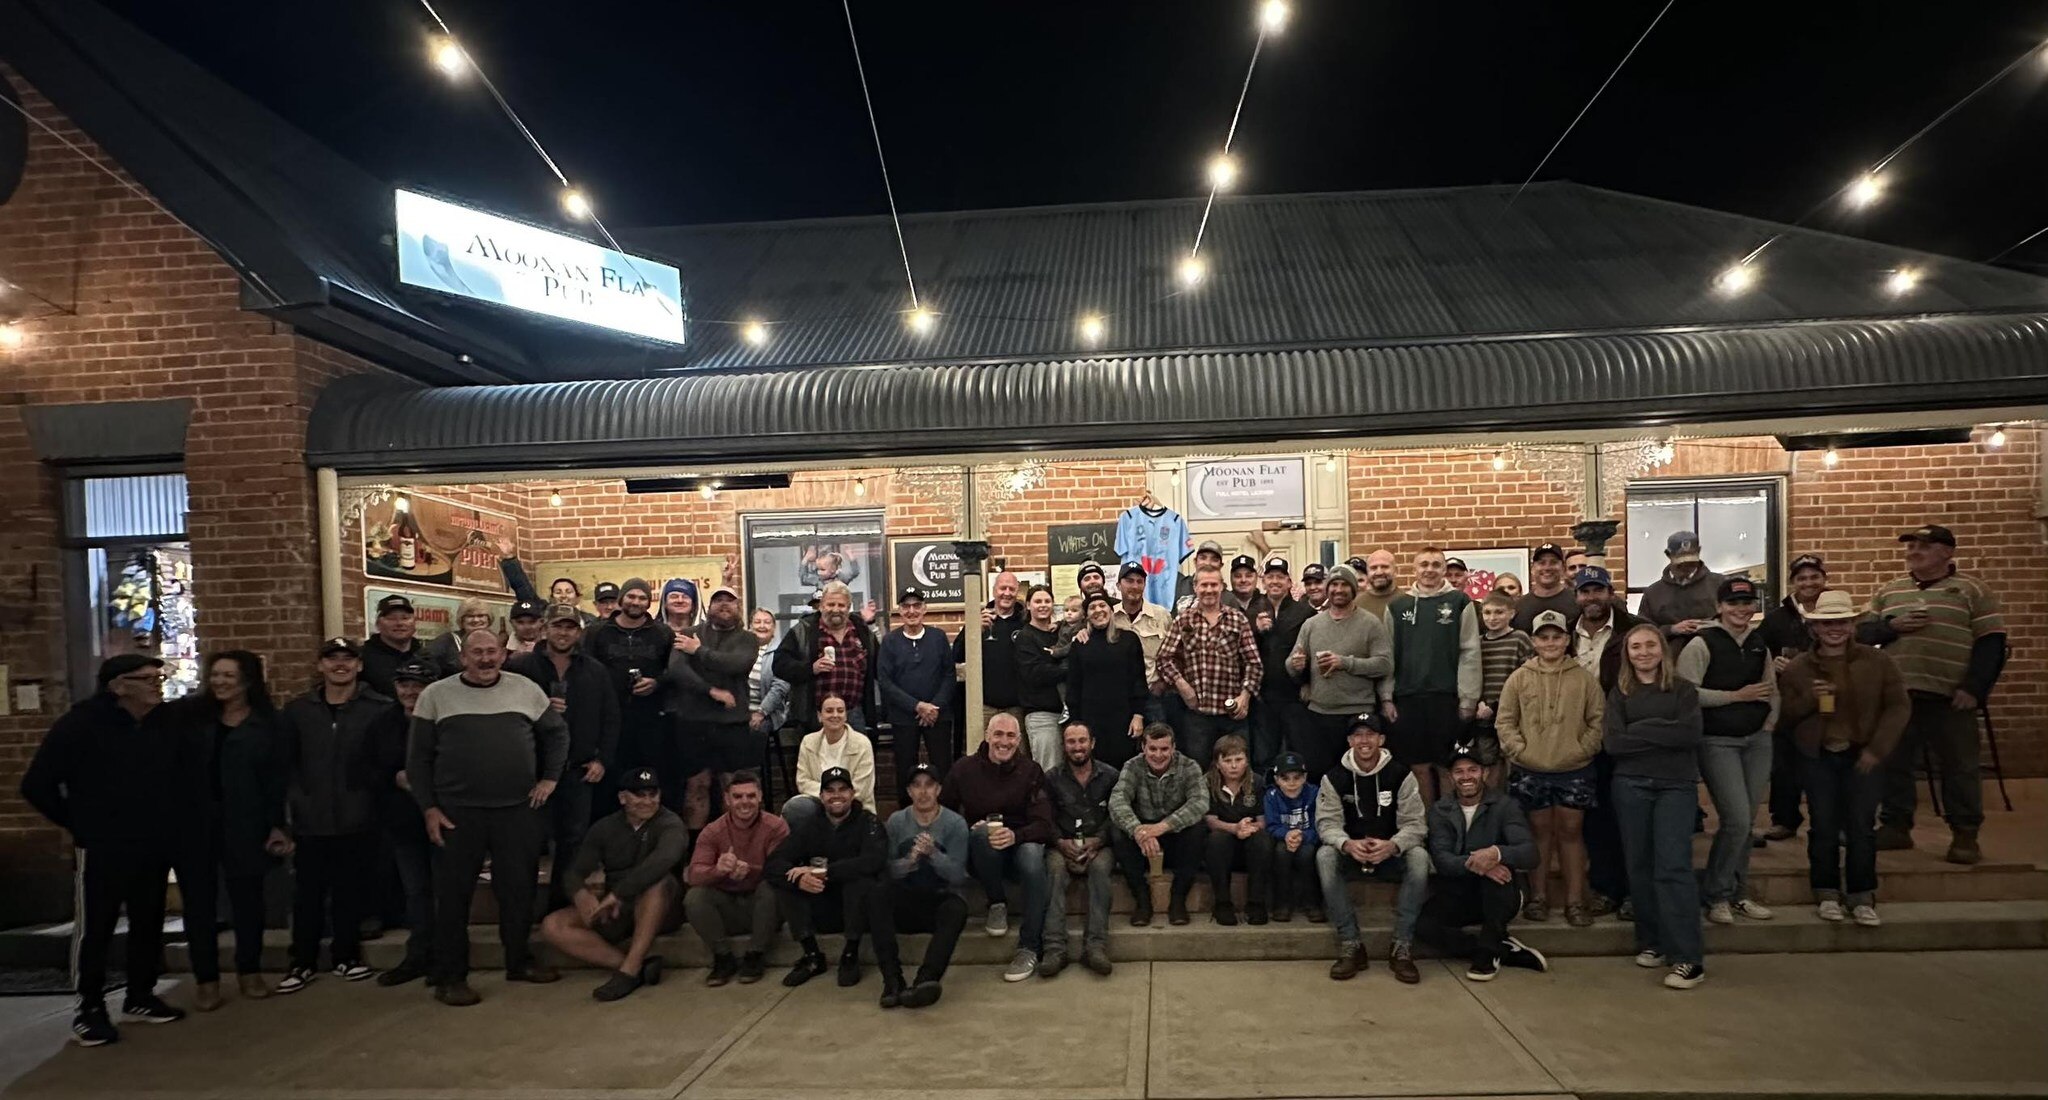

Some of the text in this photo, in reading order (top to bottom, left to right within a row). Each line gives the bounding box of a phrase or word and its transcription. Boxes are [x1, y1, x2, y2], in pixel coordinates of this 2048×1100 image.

[1092, 530, 1108, 546] ON
[460, 548, 499, 571] PORT
[928, 553, 960, 561] MOONA
